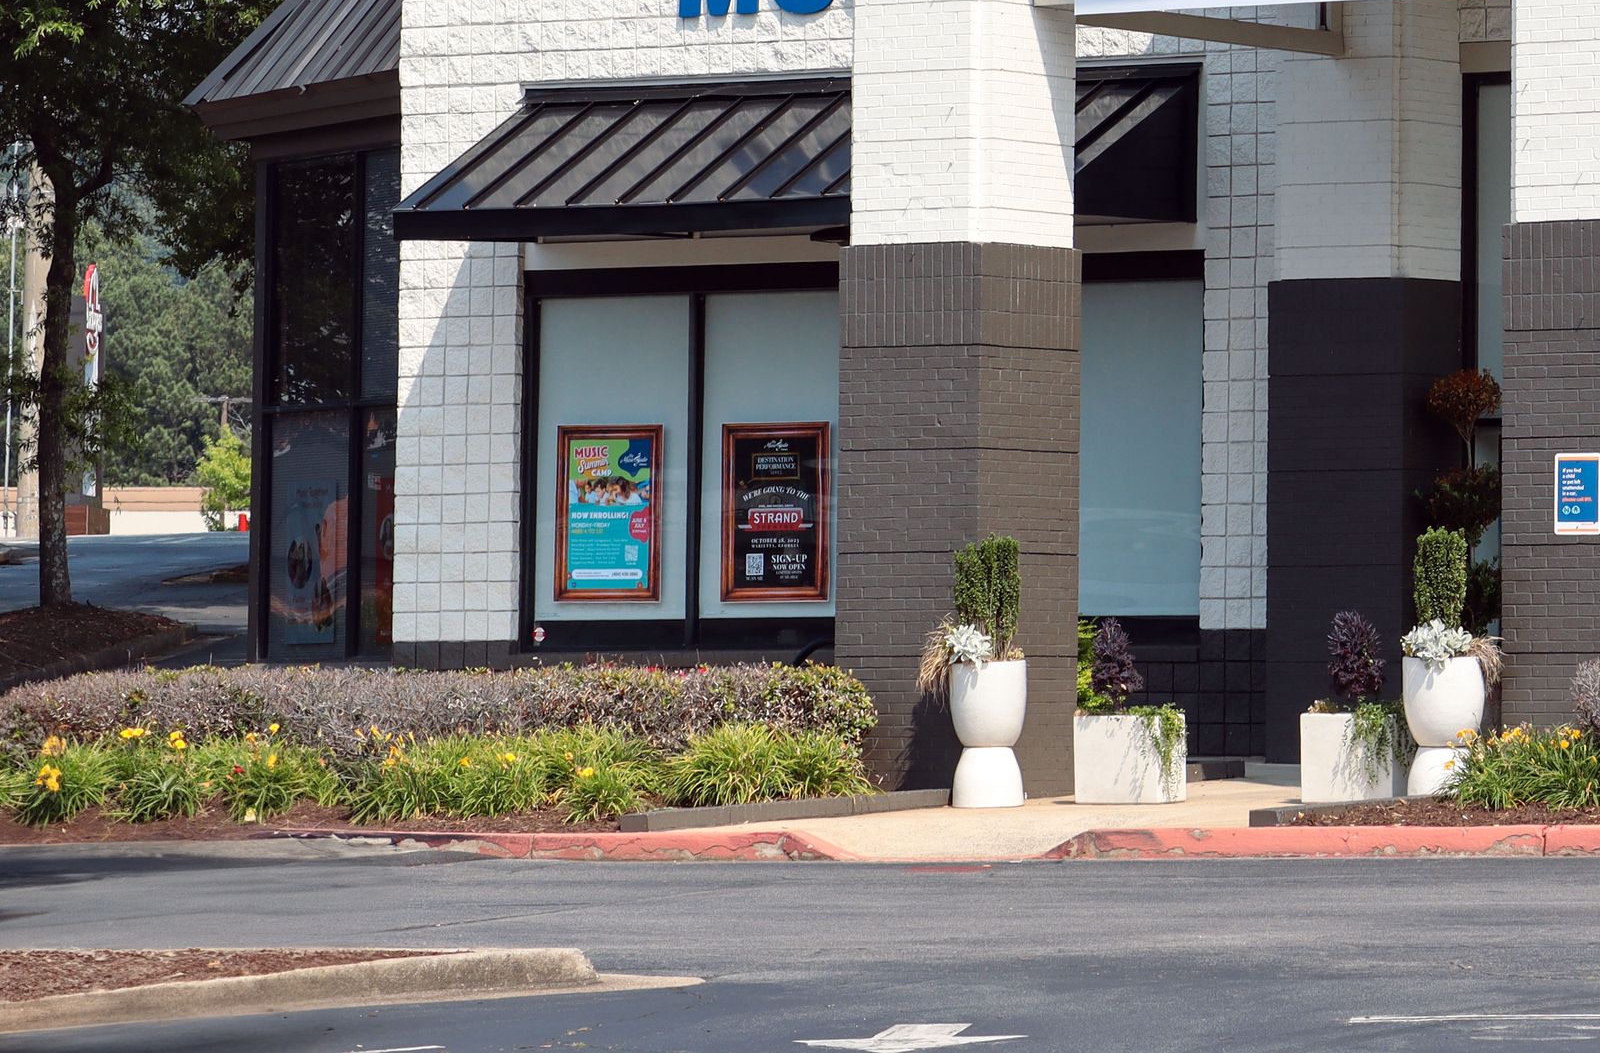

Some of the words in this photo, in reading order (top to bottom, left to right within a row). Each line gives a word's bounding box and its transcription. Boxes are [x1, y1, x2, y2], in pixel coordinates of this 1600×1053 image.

[574, 446, 608, 458] MUSIC
[591, 469, 612, 477] CAMP
[762, 485, 785, 494] GOING
[786, 487, 795, 495] TO
[753, 512, 798, 524] STRAND
[771, 554, 808, 563] SIGN-UP
